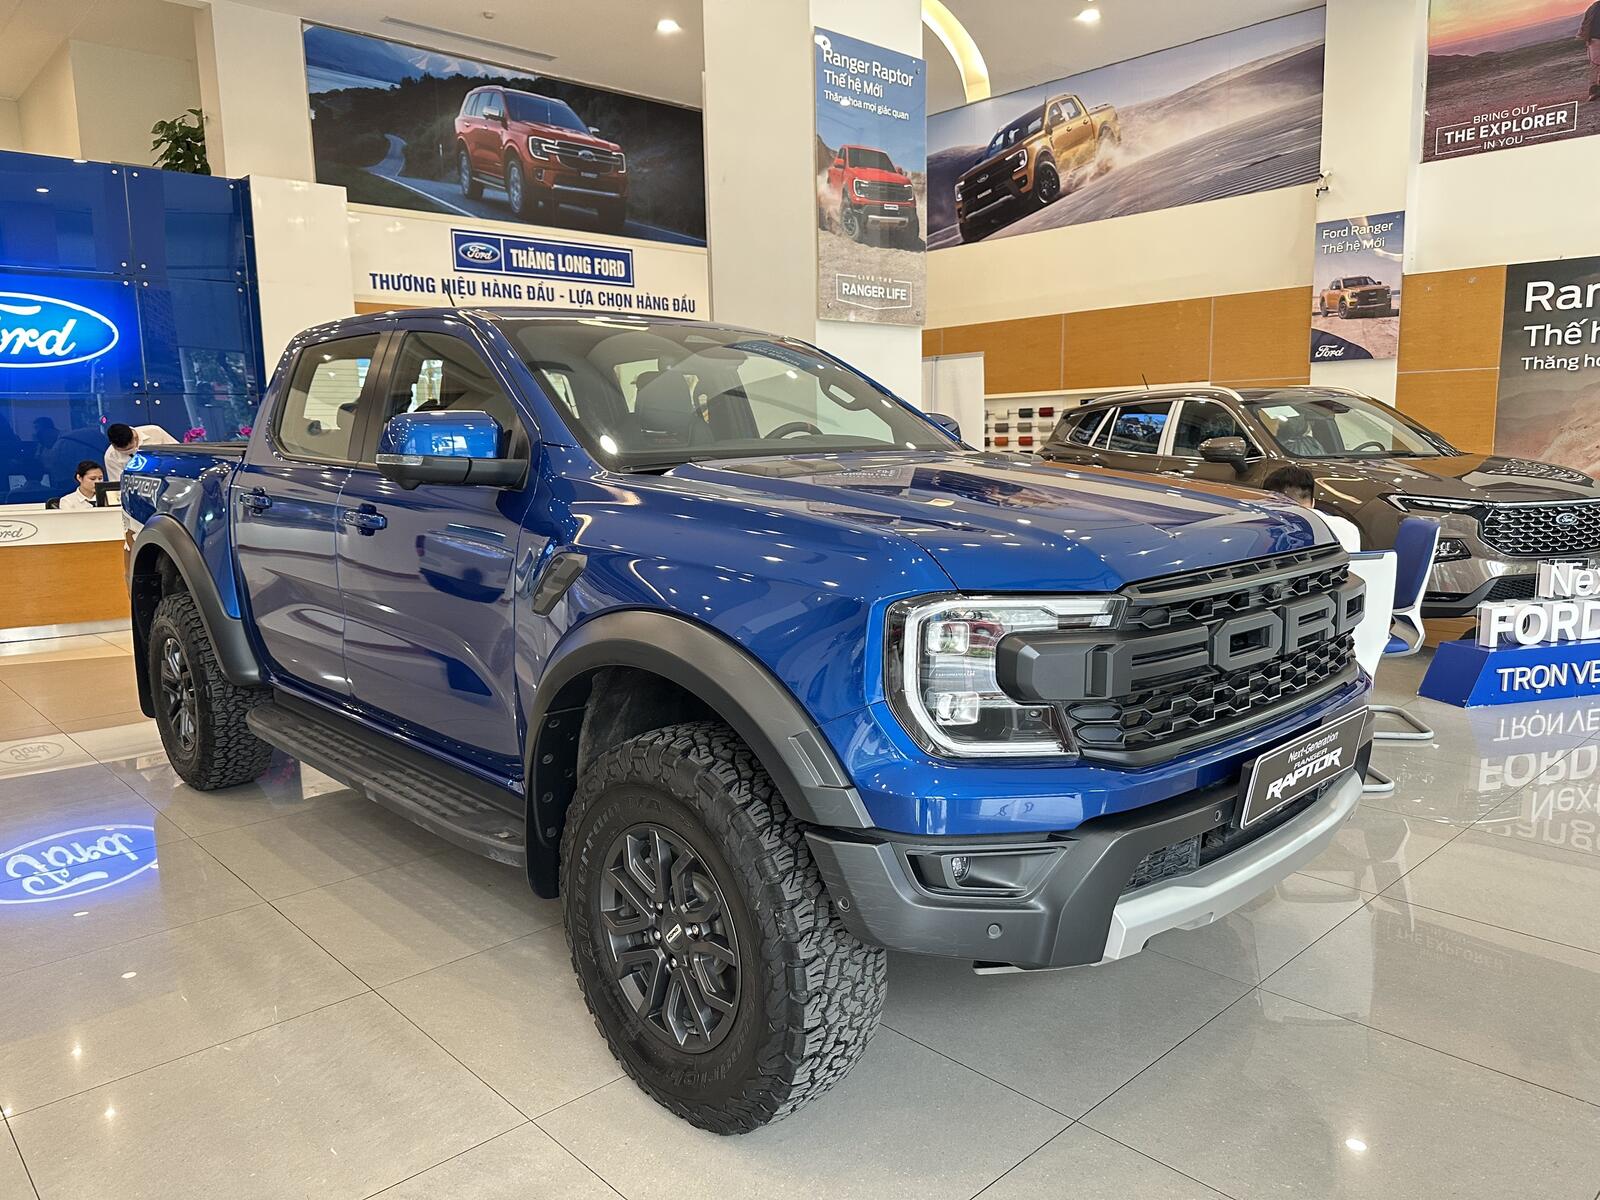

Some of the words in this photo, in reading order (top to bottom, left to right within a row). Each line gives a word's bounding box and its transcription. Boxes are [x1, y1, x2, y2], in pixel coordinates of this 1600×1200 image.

[823, 47, 870, 75] Ranger
[872, 61, 914, 87] Raptor
[824, 69, 847, 88] Thế
[848, 77, 861, 95] hệ
[863, 80, 883, 98] Mới
[892, 109, 910, 121] quan
[1444, 127, 1476, 145] THE
[1479, 109, 1568, 139] EXPLORER
[1473, 111, 1509, 125] BRING
[1511, 104, 1538, 117] OUT
[1483, 140, 1496, 150] IN
[1499, 135, 1523, 148] YOU
[1322, 225, 1349, 240] Ford
[1351, 221, 1394, 236] Ranger
[1321, 240, 1345, 255] Thế
[1345, 241, 1361, 254] hệ
[1362, 237, 1386, 250] Mới
[466, 243, 493, 261] Ford
[509, 247, 556, 272] THĂNG
[557, 253, 592, 276] LONG
[594, 256, 626, 279] FORD
[369, 272, 436, 294] THƯƠNG
[482, 278, 522, 300] HÀNG
[598, 291, 633, 311] CHỌN
[636, 291, 670, 312] HÀNG
[842, 282, 885, 299] RANGER
[886, 286, 907, 301] LIFE
[0, 304, 78, 357] rd
[1523, 318, 1589, 347] Thế
[1314, 344, 1344, 358] Ford
[1521, 355, 1580, 371] Thăng
[1496, 662, 1568, 694] TRỌN
[1287, 730, 1339, 764] Next-Generation
[1293, 747, 1328, 770] RANGER
[1265, 746, 1343, 801] RAPTOR
